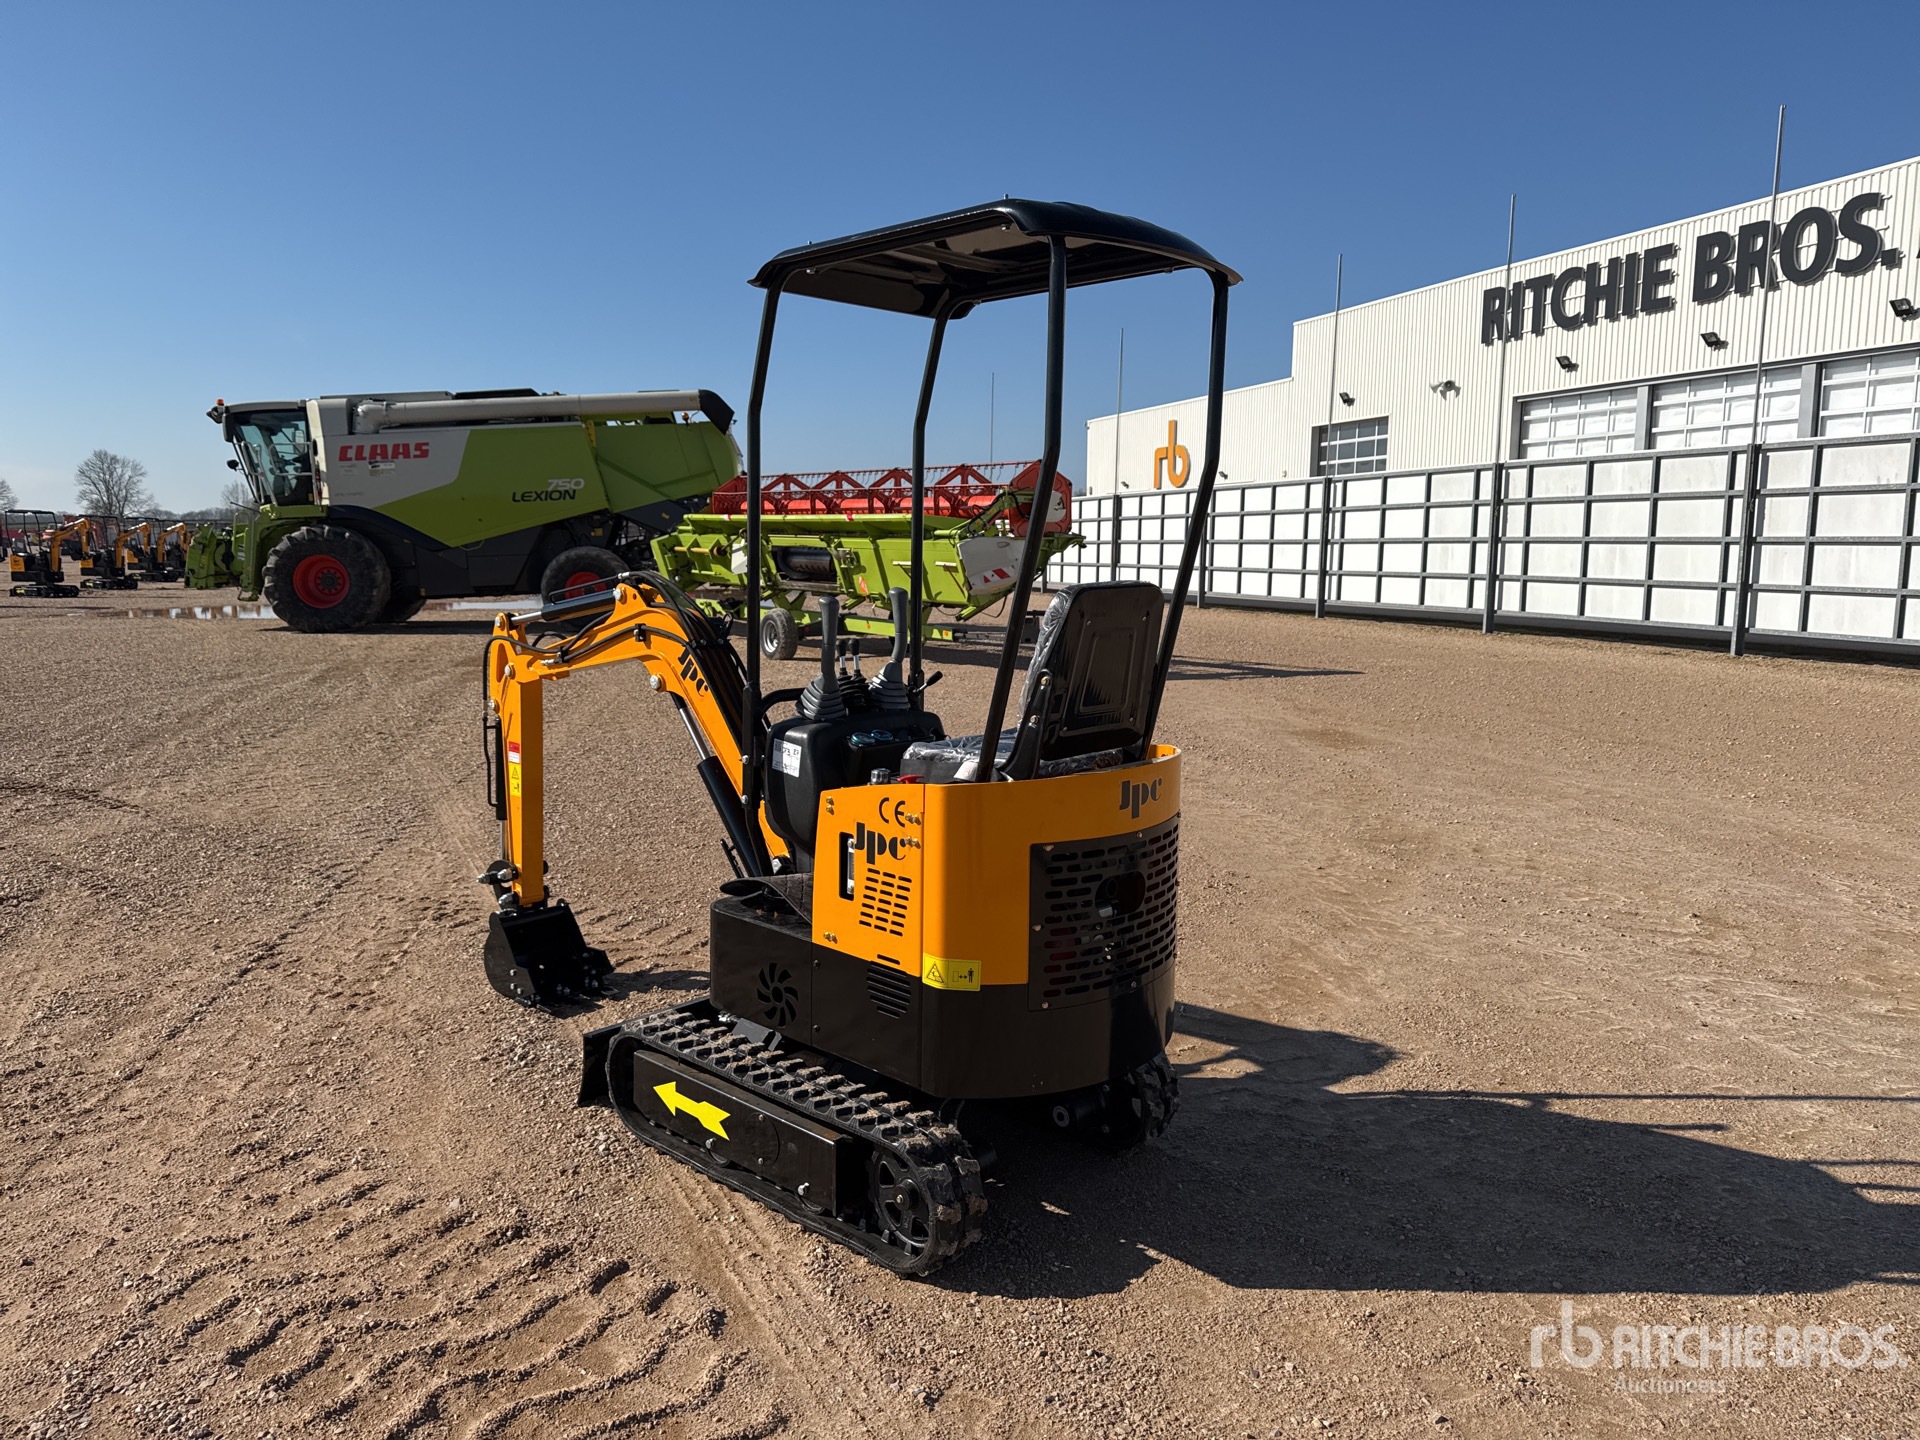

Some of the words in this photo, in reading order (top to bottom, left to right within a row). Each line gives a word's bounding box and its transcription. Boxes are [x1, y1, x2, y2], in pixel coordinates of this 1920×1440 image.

[1481, 242, 1677, 345] RITCHIE
[1692, 191, 1900, 303] BROS.
[338, 441, 430, 461] CLAAS
[1154, 419, 1190, 489] rb
[512, 489, 576, 502] LEXION
[547, 478, 585, 490] 750
[878, 797, 906, 828] CE
